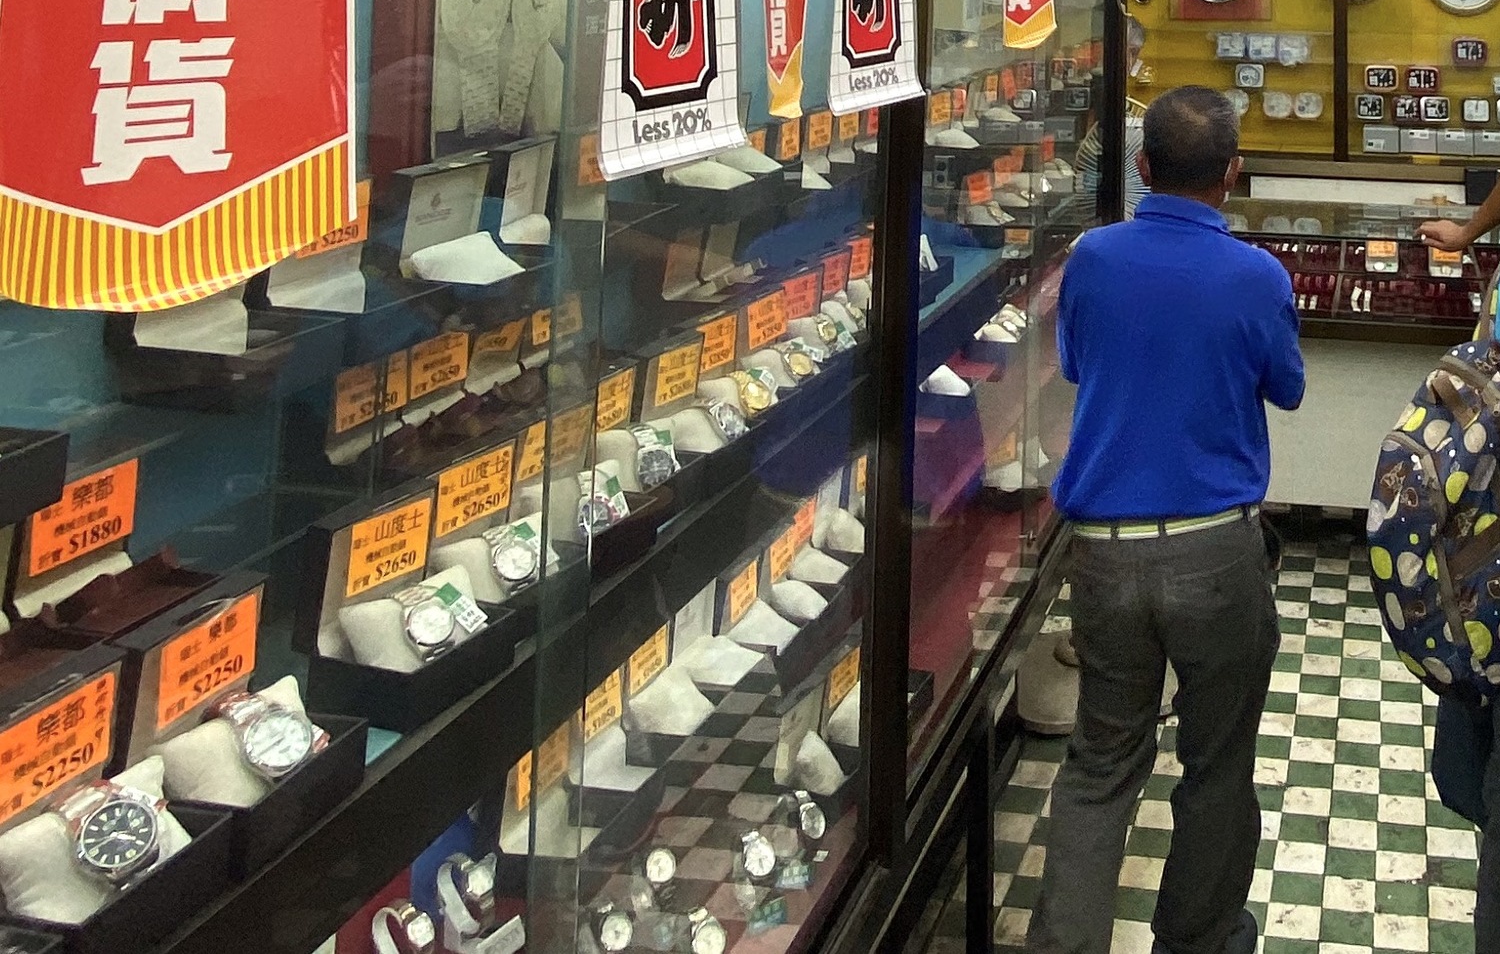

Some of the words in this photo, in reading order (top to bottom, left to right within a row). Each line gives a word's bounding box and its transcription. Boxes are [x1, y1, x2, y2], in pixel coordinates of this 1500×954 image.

[849, 74, 872, 92] Less
[873, 66, 899, 88] 20%
[632, 119, 670, 144] Less
[672, 107, 711, 137] 20%
[375, 508, 424, 543] 山度士
[462, 494, 500, 523] $2650
[69, 515, 122, 554] $1880
[375, 549, 416, 581] $2650
[193, 654, 243, 701] $2250
[31, 742, 94, 797] $2250
